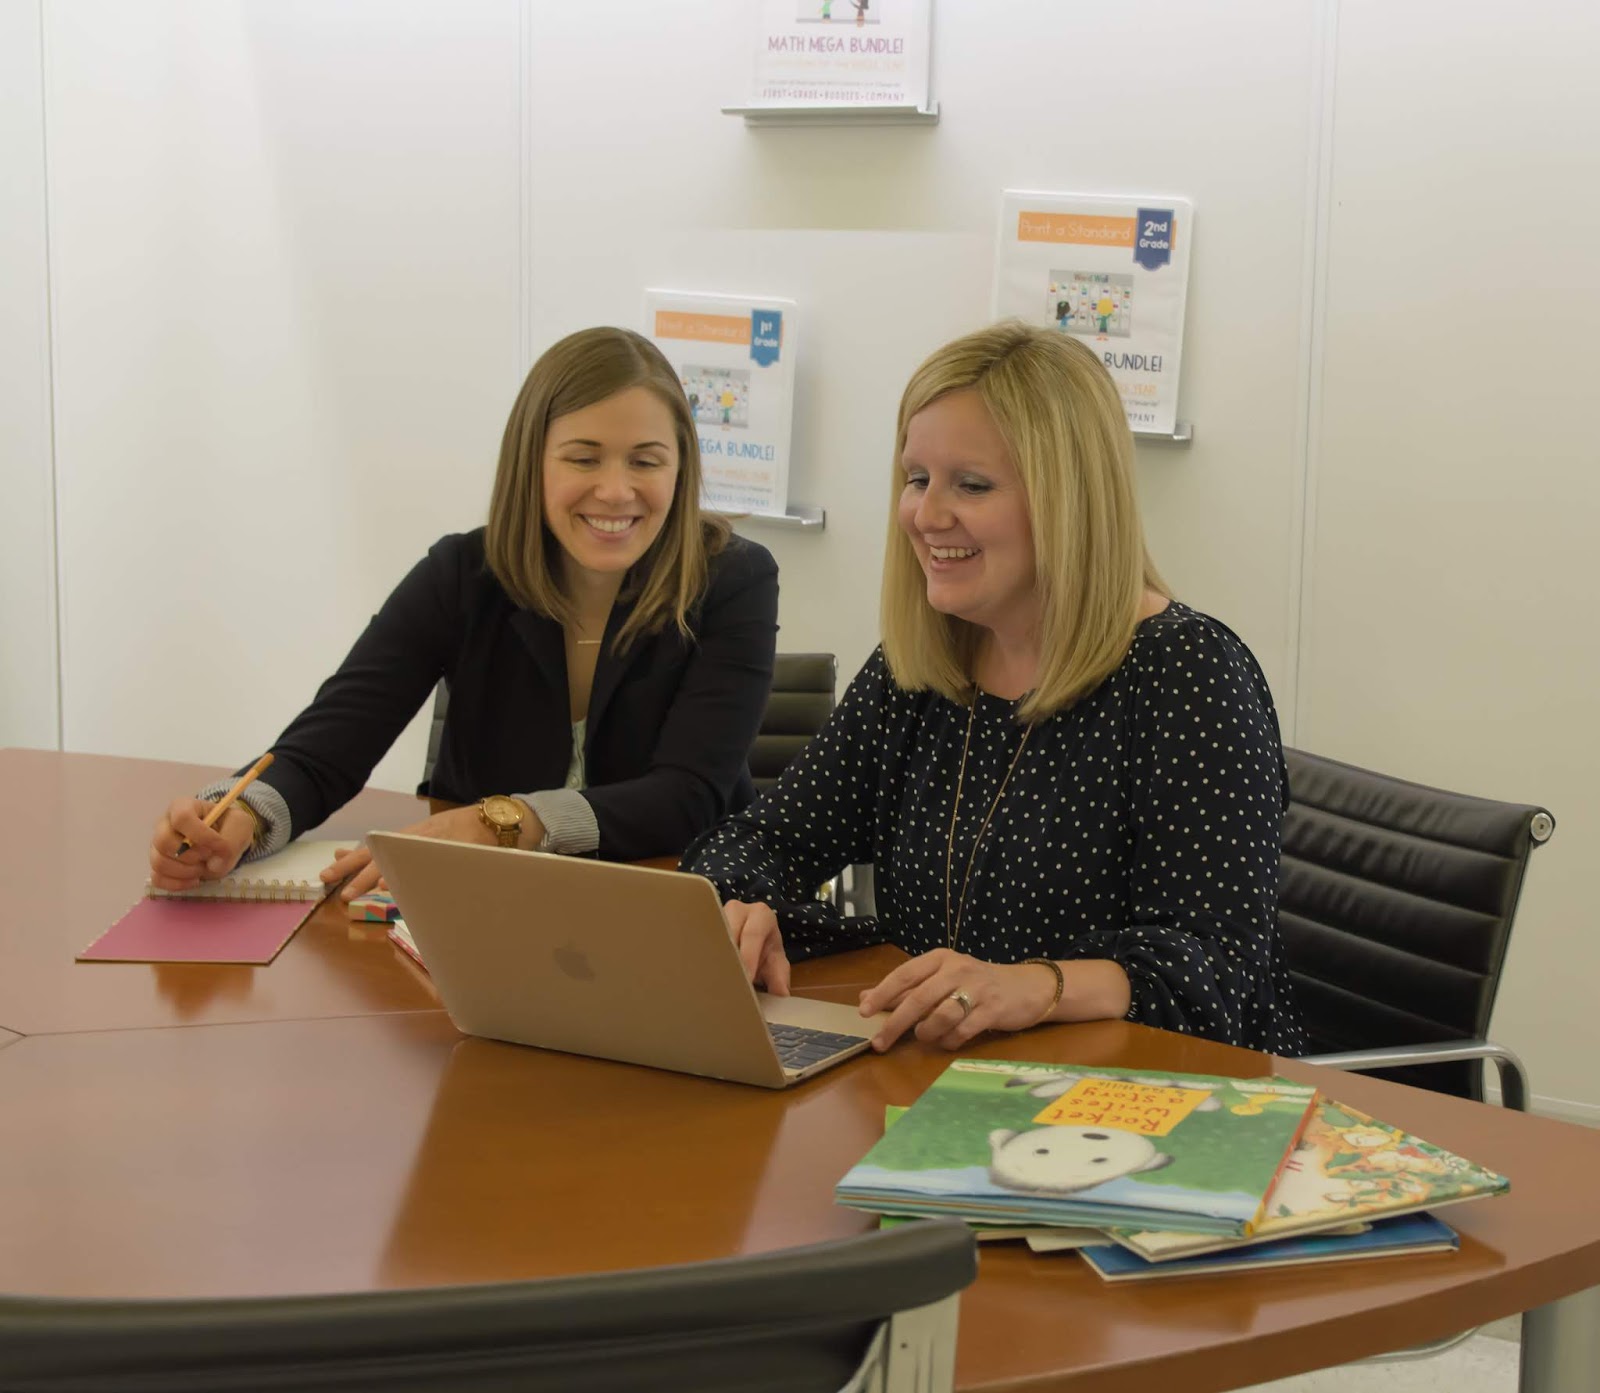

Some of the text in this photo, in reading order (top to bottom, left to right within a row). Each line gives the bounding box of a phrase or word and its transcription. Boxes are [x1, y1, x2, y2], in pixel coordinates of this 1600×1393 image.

[768, 35, 904, 54] MATH MEGA BUNDLE!
[1055, 225, 1066, 236] a
[1068, 221, 1132, 241] Standard
[1143, 220, 1168, 237] 2nd
[1139, 239, 1170, 250] Grade
[753, 337, 779, 348] Grade
[1103, 352, 1162, 372] BUNDLE!
[698, 438, 776, 461] EGA BUNDLE!
[1070, 1098, 1171, 1118] Writes
[1168, 1097, 1185, 1105] a
[1051, 1109, 1161, 1132] Rocket
